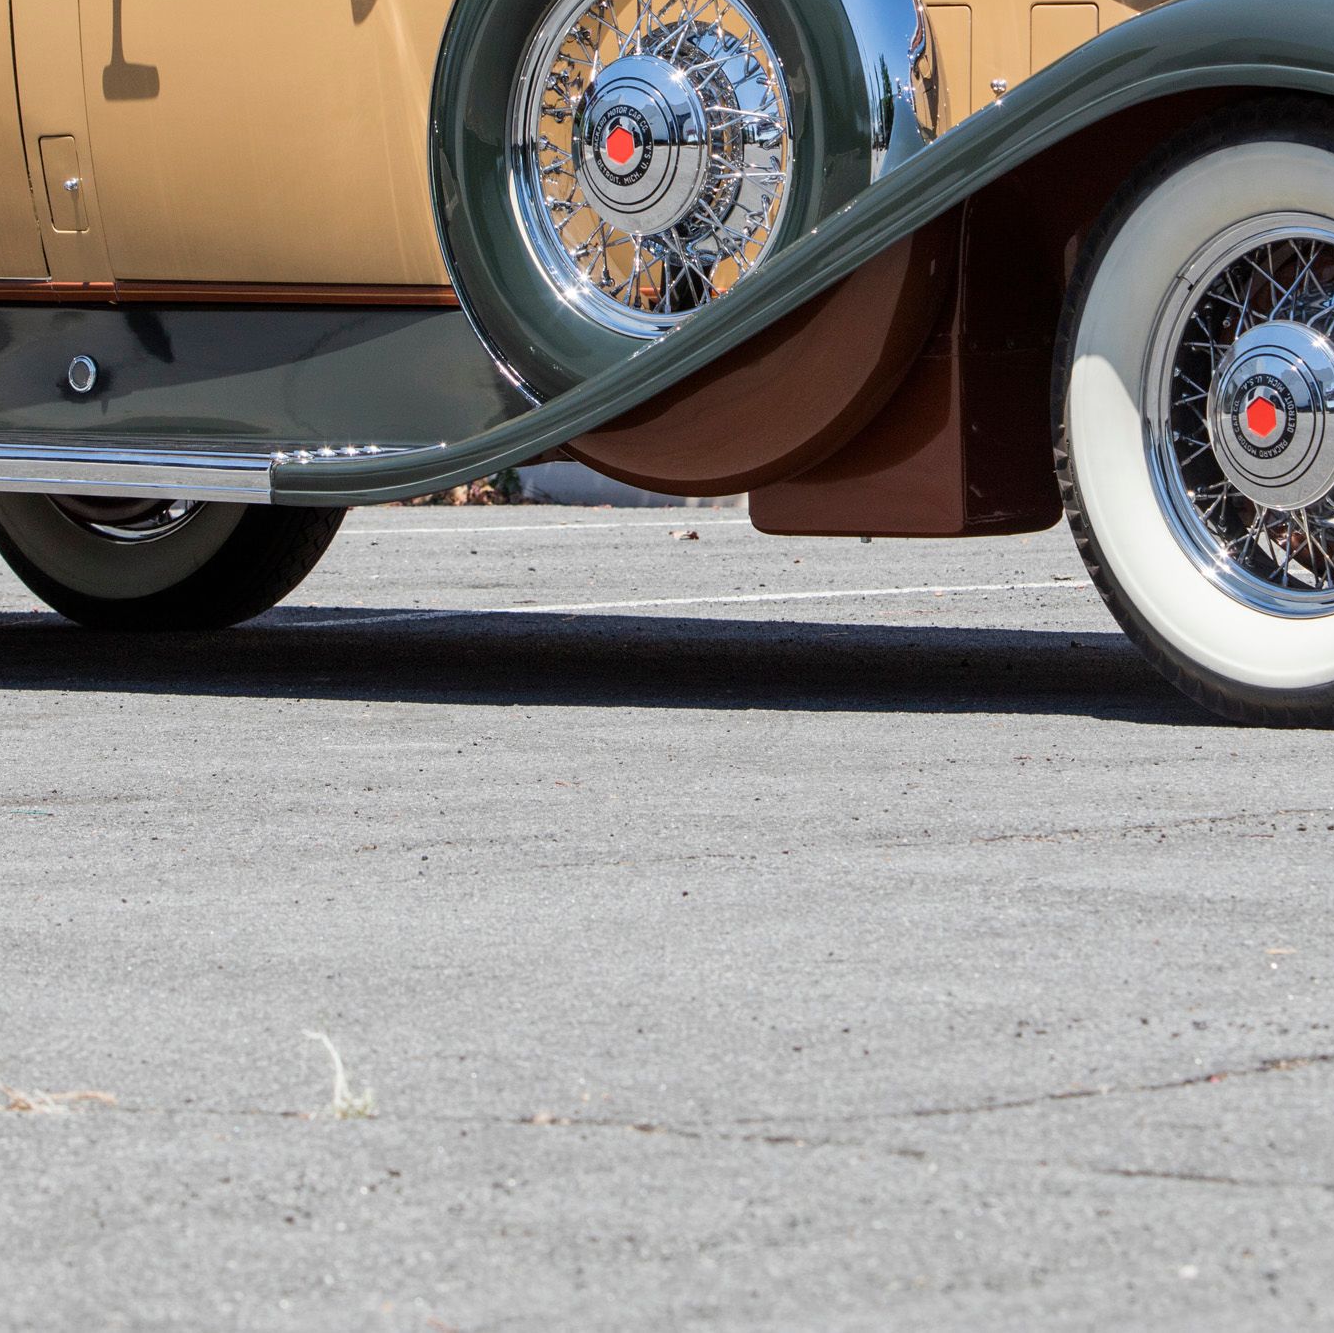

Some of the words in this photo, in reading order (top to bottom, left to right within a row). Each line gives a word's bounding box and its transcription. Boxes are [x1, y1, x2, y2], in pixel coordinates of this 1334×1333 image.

[594, 117, 607, 152] PACKARD
[607, 106, 628, 119] MOTOR
[628, 108, 642, 121] CAR
[623, 172, 643, 184] MICH.
[1267, 376, 1285, 393] MICH.
[1237, 435, 1257, 455] MOTOR
[1259, 439, 1288, 458] PACKARD
